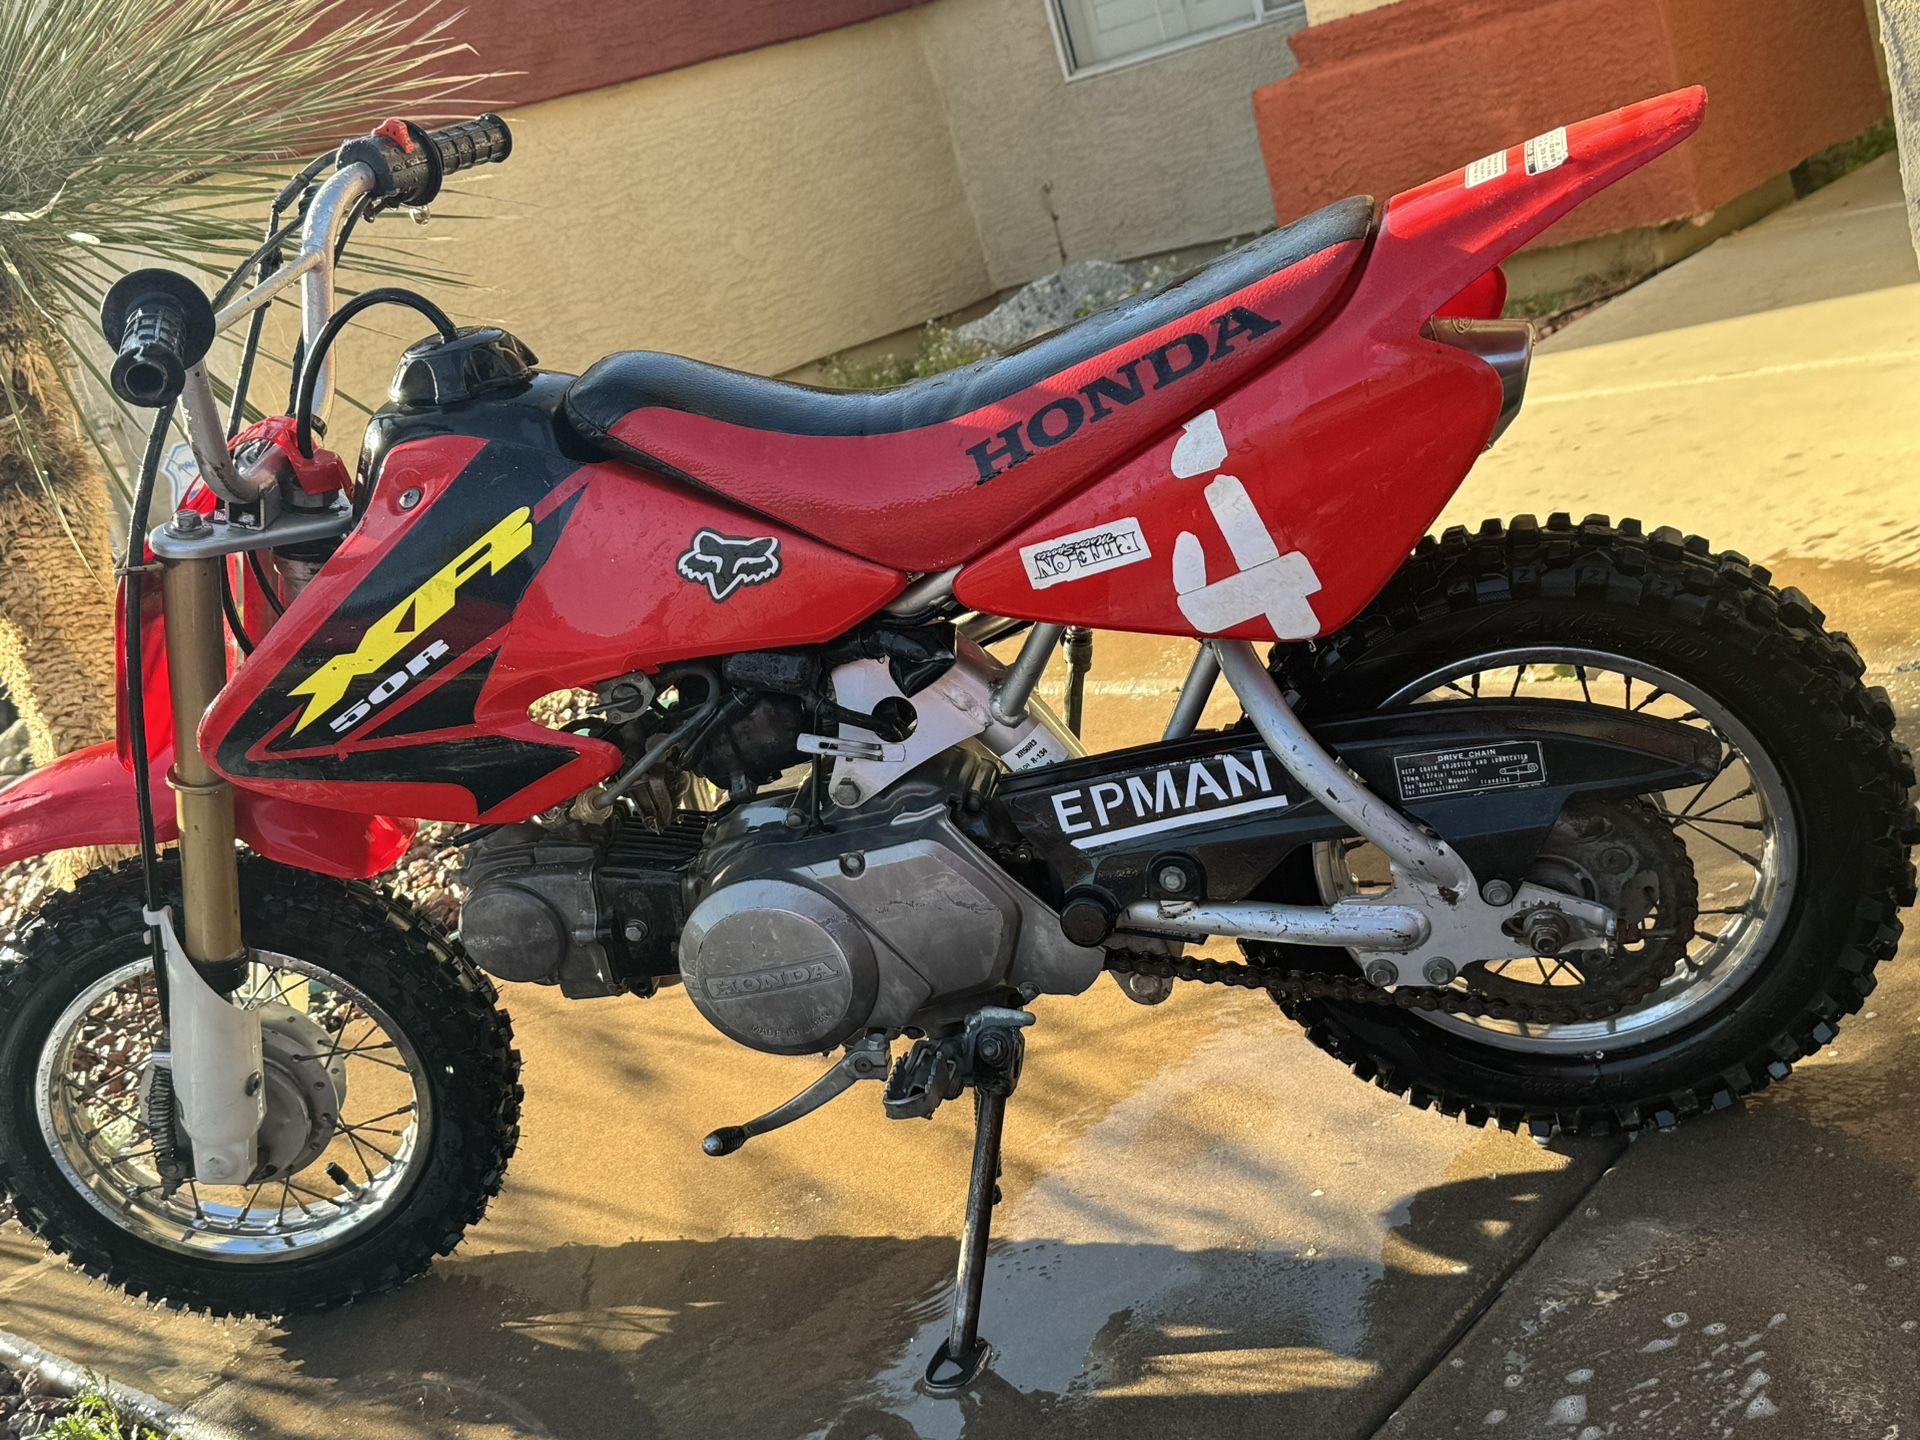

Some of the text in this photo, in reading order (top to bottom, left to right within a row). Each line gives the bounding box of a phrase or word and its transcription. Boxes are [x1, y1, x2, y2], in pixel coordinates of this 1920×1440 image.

[966, 306, 1282, 486] HONDA
[287, 506, 533, 738] XR
[329, 639, 450, 733] 50R
[1030, 747, 1047, 764] R-134
[1401, 767, 1417, 775] KEEP
[1419, 764, 1438, 773] CHAIN
[1442, 760, 1471, 770] ADJUSTED
[1491, 753, 1528, 764] LUBRICATED
[1437, 749, 1496, 762] DRIVE CHAIN
[1051, 750, 1271, 834] EPMAN
[713, 962, 838, 996] HONDA
[751, 1023, 781, 1039] MADE
